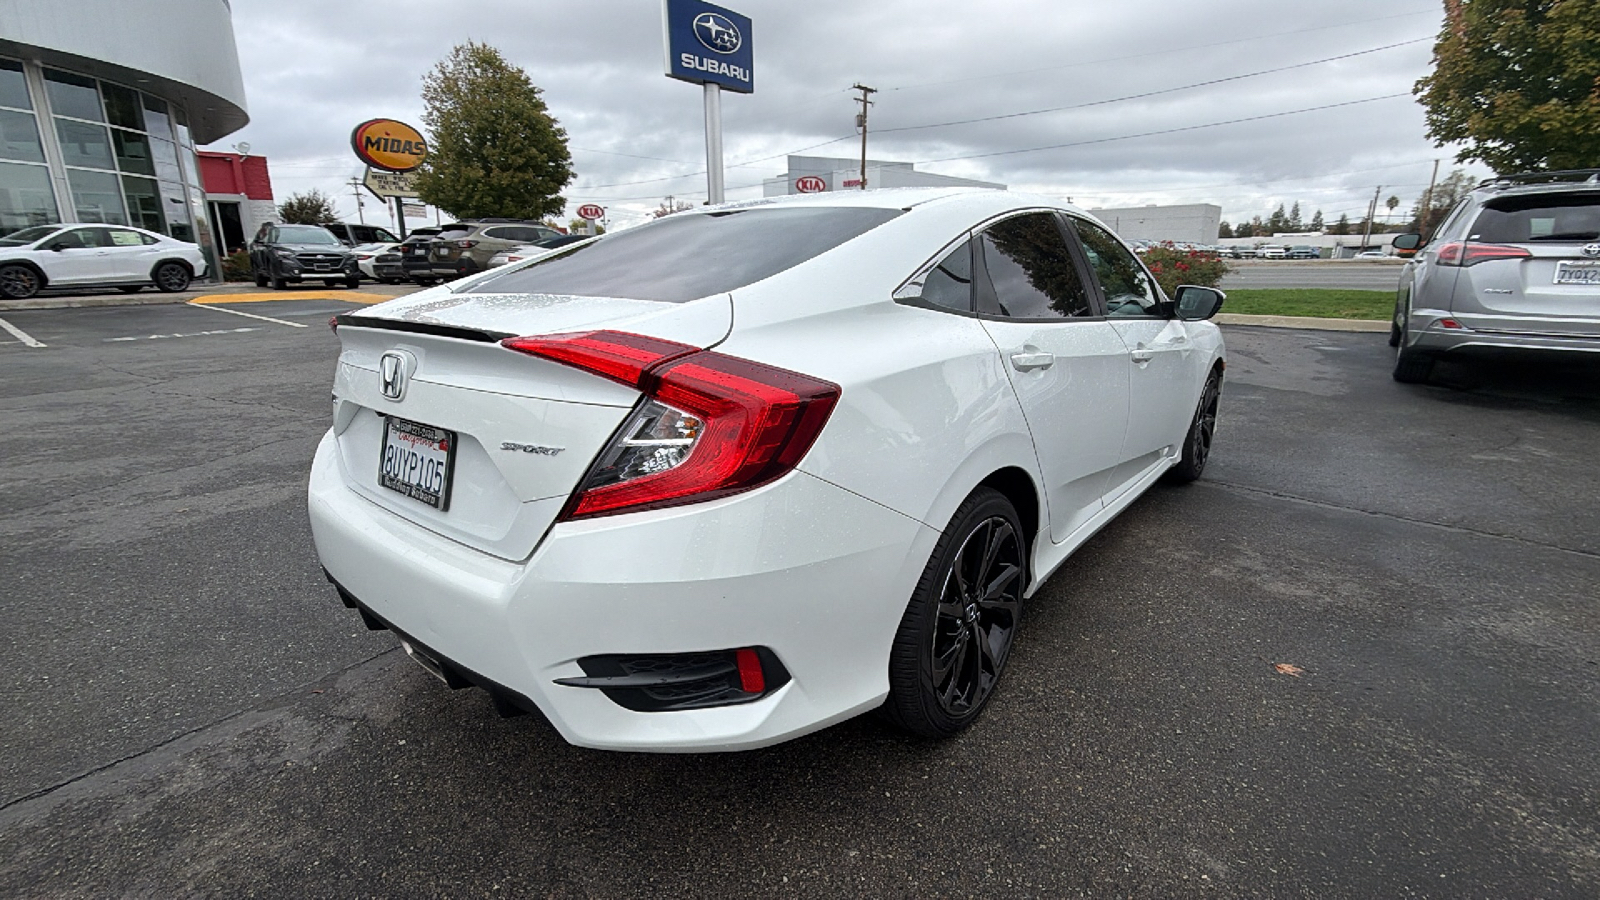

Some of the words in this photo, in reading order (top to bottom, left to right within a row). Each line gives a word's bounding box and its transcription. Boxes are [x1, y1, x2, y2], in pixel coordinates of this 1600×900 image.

[681, 53, 749, 82] SUBARU
[364, 136, 425, 155] MIDAS
[801, 179, 821, 191] KIA
[582, 207, 600, 217] KIA
[500, 442, 566, 457] SPORT
[385, 444, 444, 494] 8UYP105
